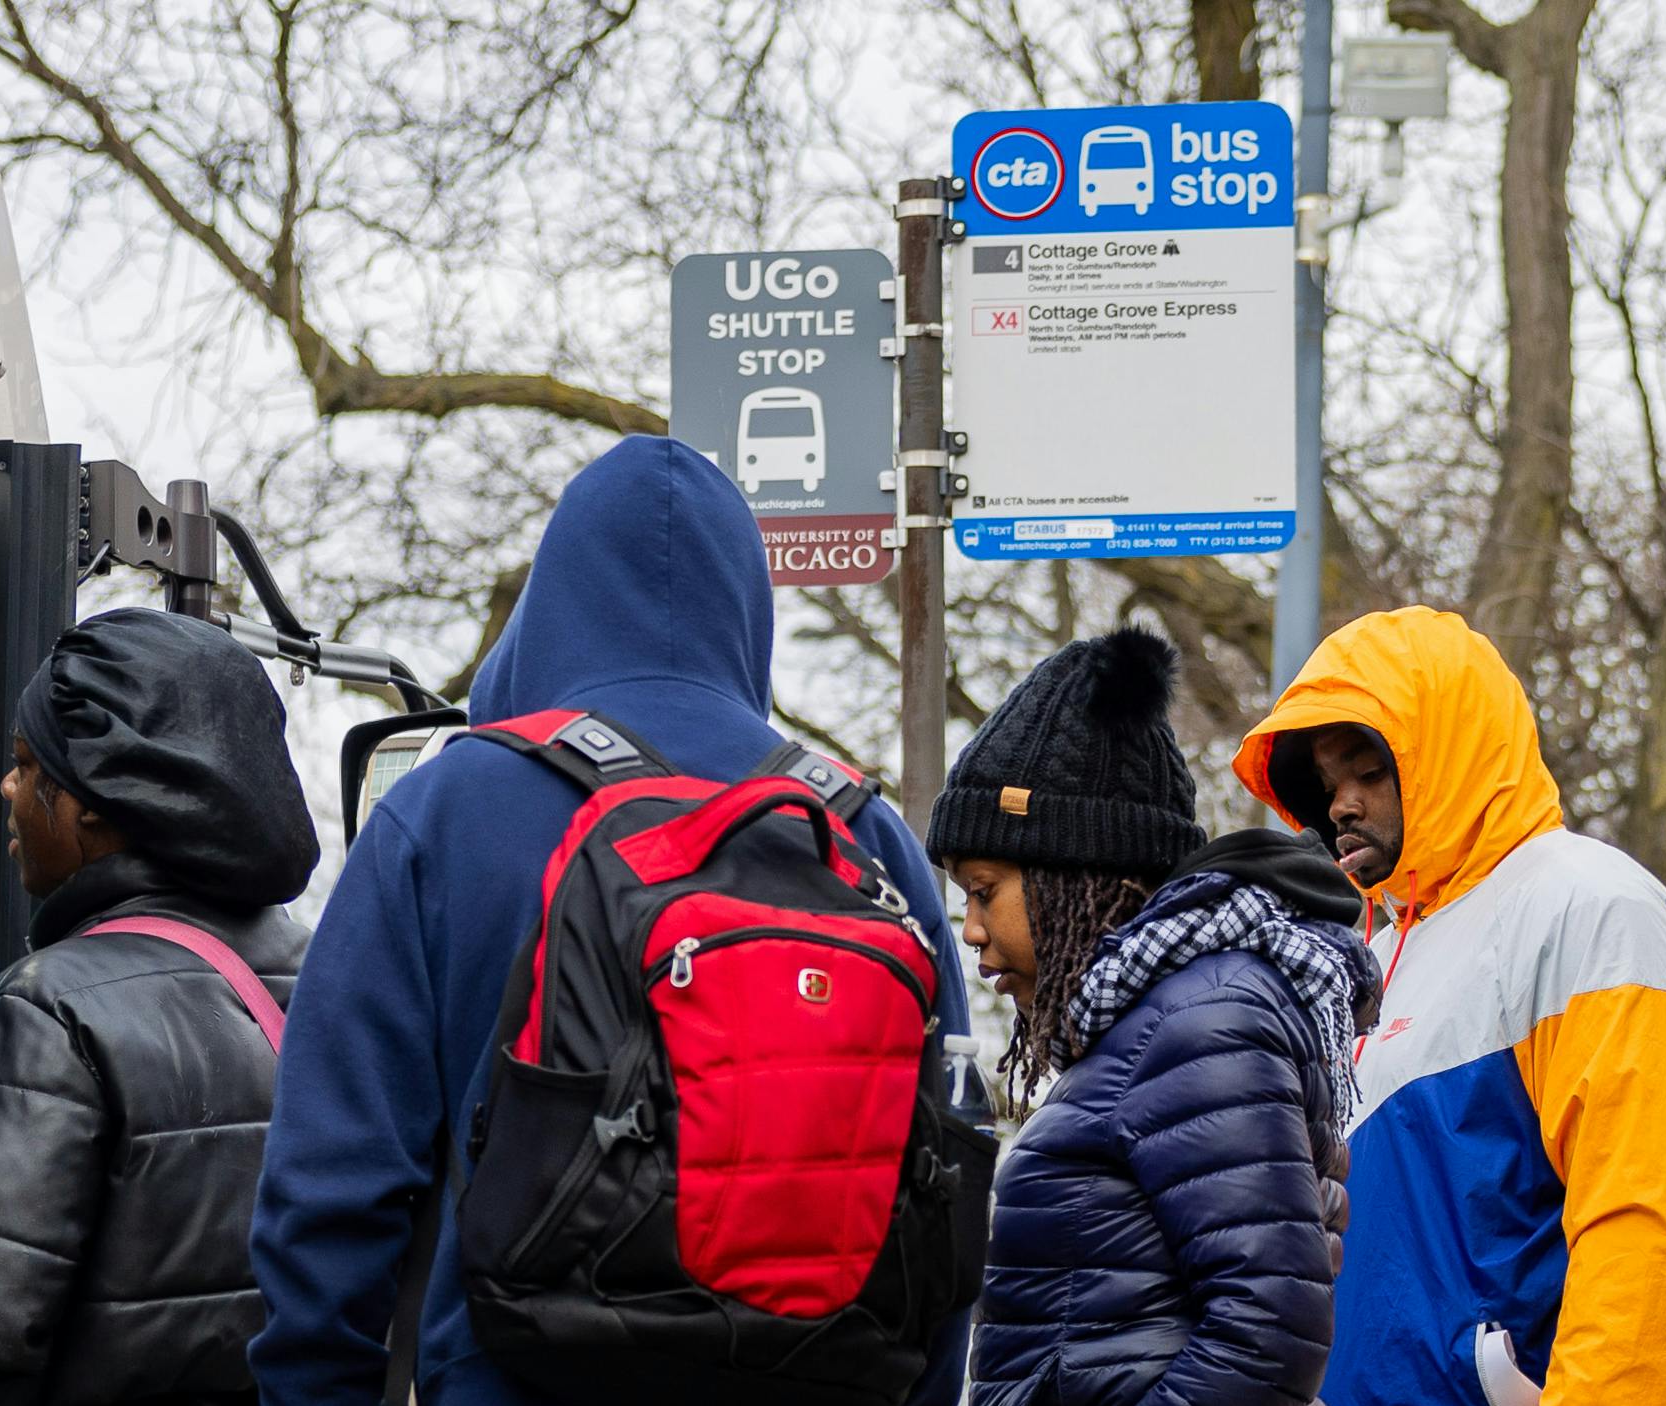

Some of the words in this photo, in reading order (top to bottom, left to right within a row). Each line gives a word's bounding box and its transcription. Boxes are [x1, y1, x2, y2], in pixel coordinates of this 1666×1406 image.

[1171, 122, 1259, 164] bus
[987, 157, 1048, 188] cta
[1170, 166, 1277, 215] stop
[1004, 249, 1020, 269] 4
[1028, 244, 1098, 261] Cottage
[1104, 242, 1158, 257] Grove
[1028, 264, 1053, 272] North
[1066, 261, 1157, 272] Columbus/Randolph
[725, 258, 839, 301] UGo
[990, 311, 1019, 330] X4
[1028, 305, 1098, 323] Cottage
[1104, 303, 1158, 318] Grove
[1164, 301, 1237, 319] Express
[708, 309, 855, 339] SHUTTLE
[1066, 323, 1157, 333] Columbus/Randolph
[1153, 331, 1186, 340] periods
[738, 349, 826, 376] STOP
[989, 498, 1000, 506] All
[1003, 498, 1023, 506] CTA
[1027, 497, 1056, 505] buses
[1077, 495, 1129, 504] accessible
[761, 530, 851, 544] UNIVERSITY
[854, 529, 875, 541] OF
[987, 526, 1012, 535] TEXT
[1017, 524, 1066, 535] CTABUS
[1127, 523, 1155, 532] 41411
[1158, 523, 1171, 531] for
[1174, 521, 1222, 531] estimated
[1224, 520, 1254, 530] arrival
[1257, 520, 1283, 529] times
[1000, 541, 1091, 551] transitchicago.com
[1189, 537, 1208, 546] TTY
[766, 545, 877, 571] ICAGO
